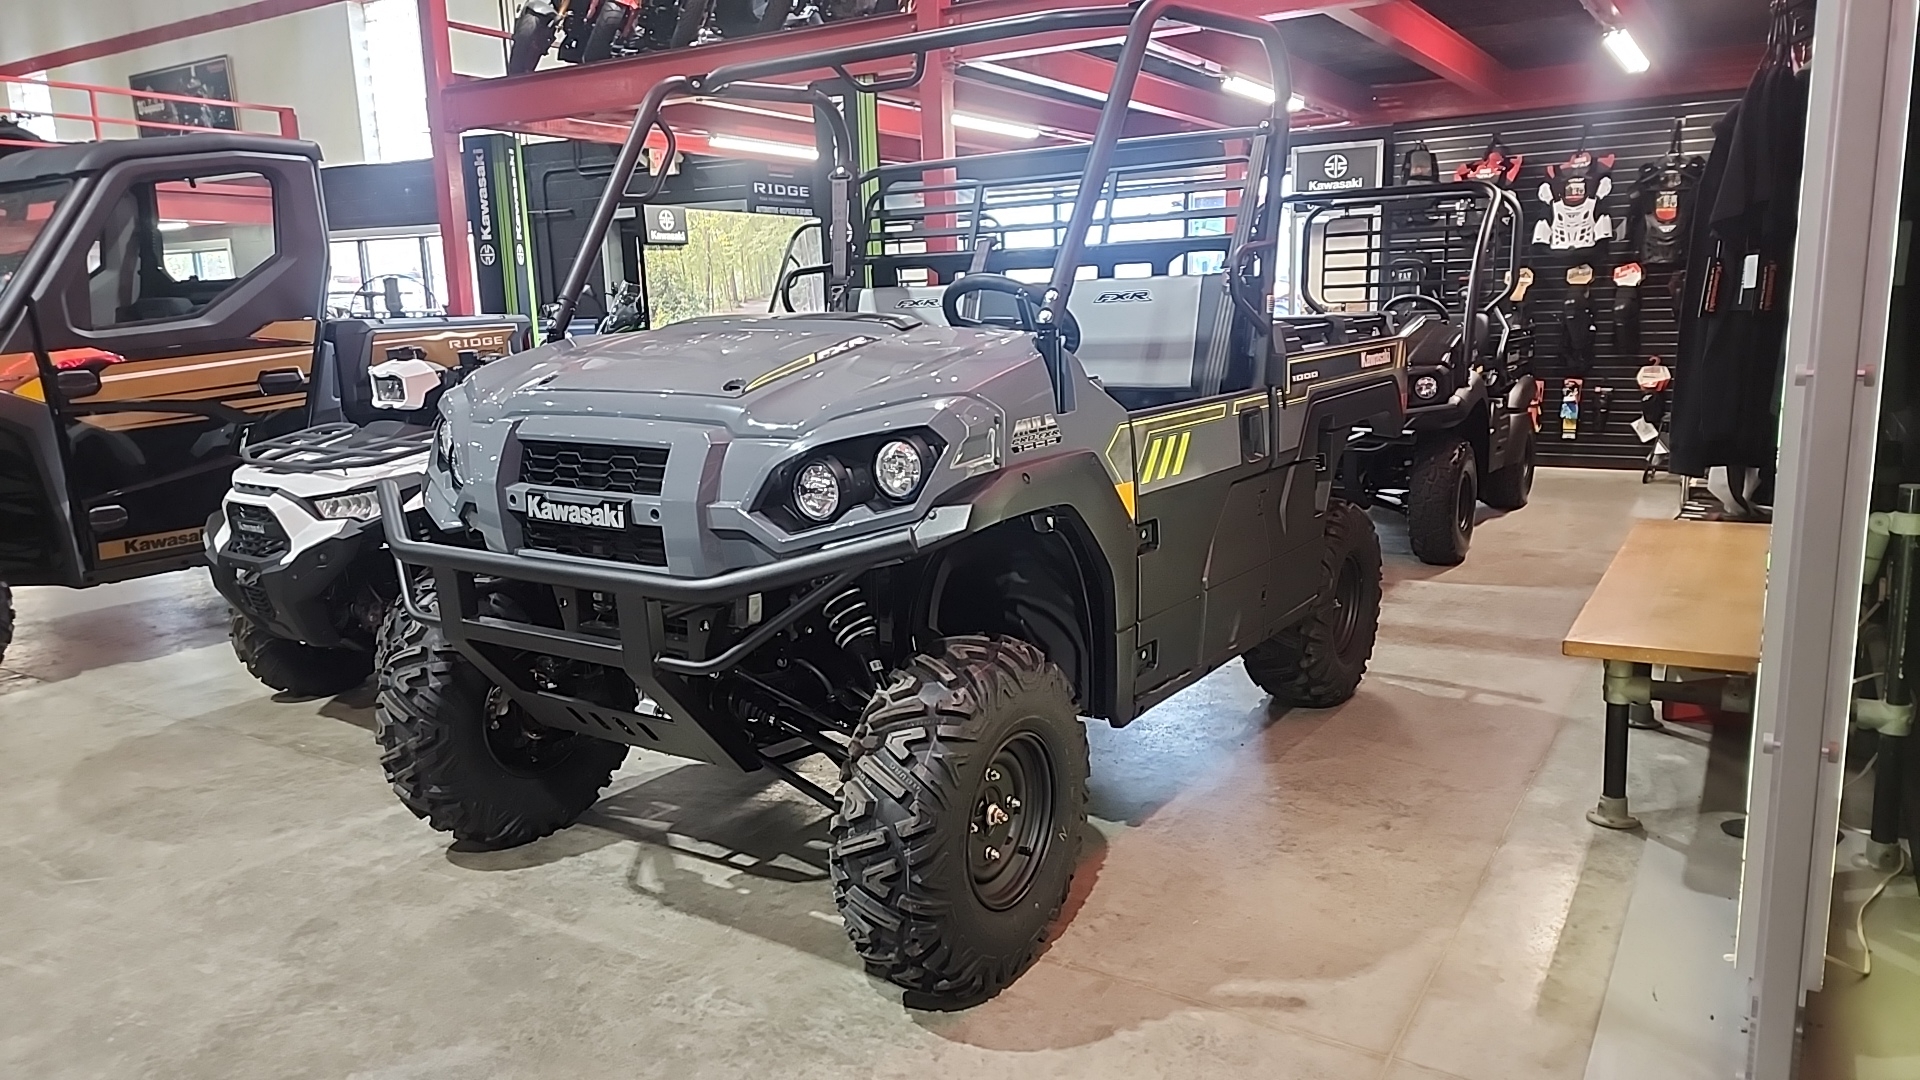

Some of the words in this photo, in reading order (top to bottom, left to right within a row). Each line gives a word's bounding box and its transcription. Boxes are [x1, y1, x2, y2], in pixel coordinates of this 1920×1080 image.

[753, 182, 810, 198] RIDGE
[1308, 177, 1363, 191] Kawasaki
[472, 148, 492, 240] Kawasaki
[650, 230, 686, 241] Kawasaki
[448, 335, 504, 349] RIDGE
[1291, 370, 1319, 382] 1000
[527, 494, 625, 529] Kawasaki
[124, 528, 204, 554] Kawasa
